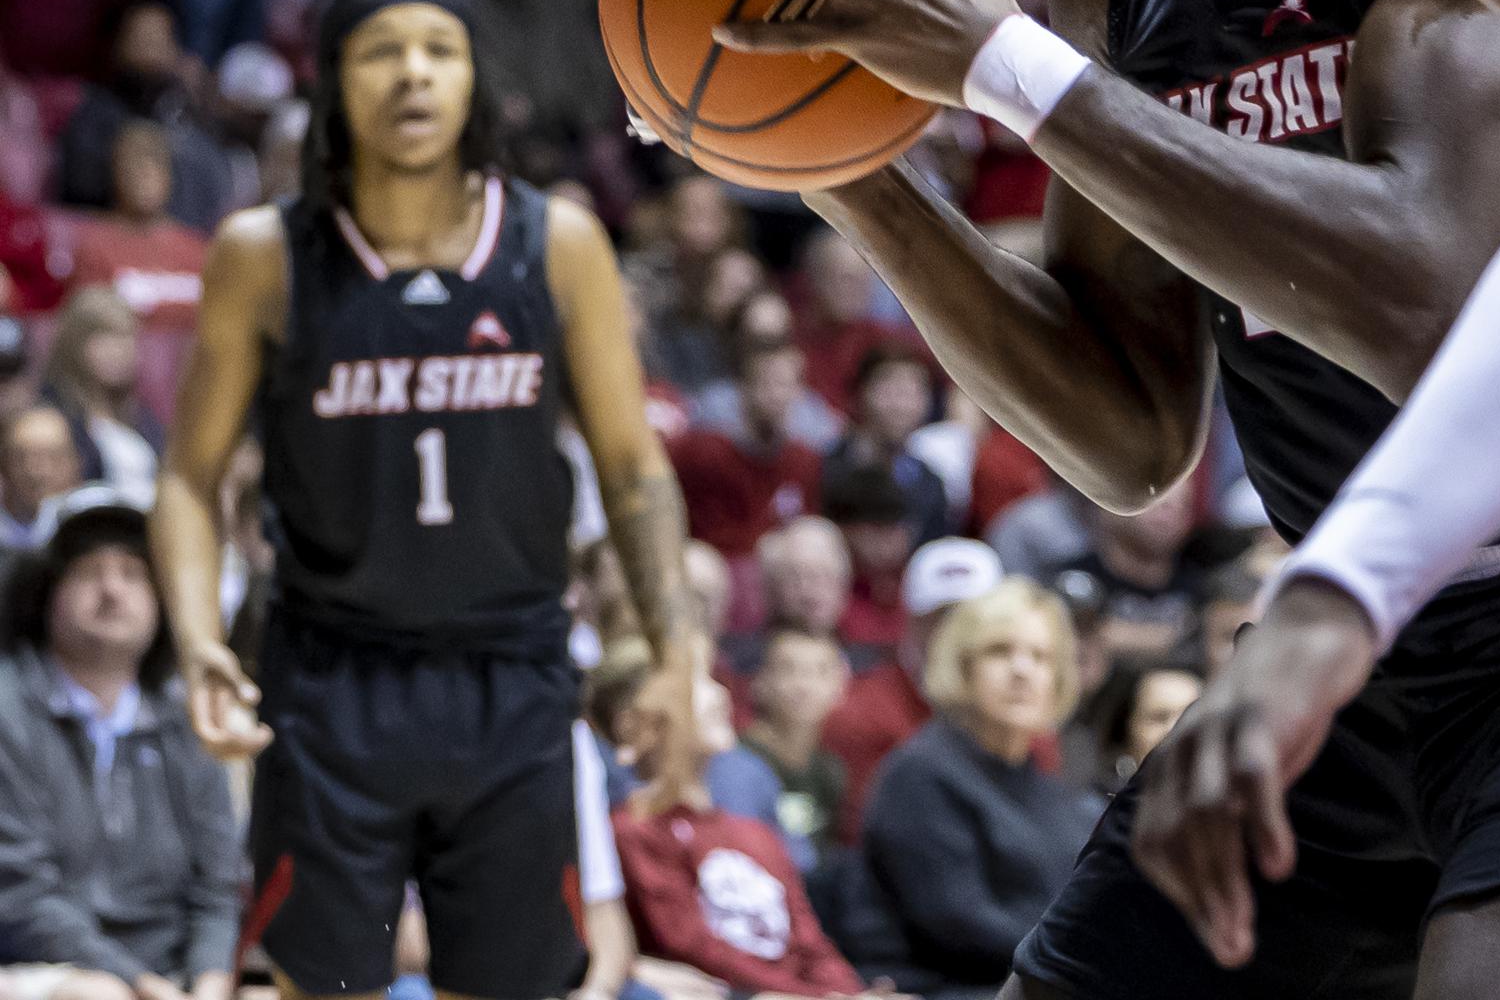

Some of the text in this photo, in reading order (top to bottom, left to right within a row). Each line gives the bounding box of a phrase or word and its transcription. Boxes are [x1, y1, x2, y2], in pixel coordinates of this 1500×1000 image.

[1226, 38, 1354, 143] STAT
[312, 352, 544, 418] JAX STATE
[413, 427, 454, 526] 1
